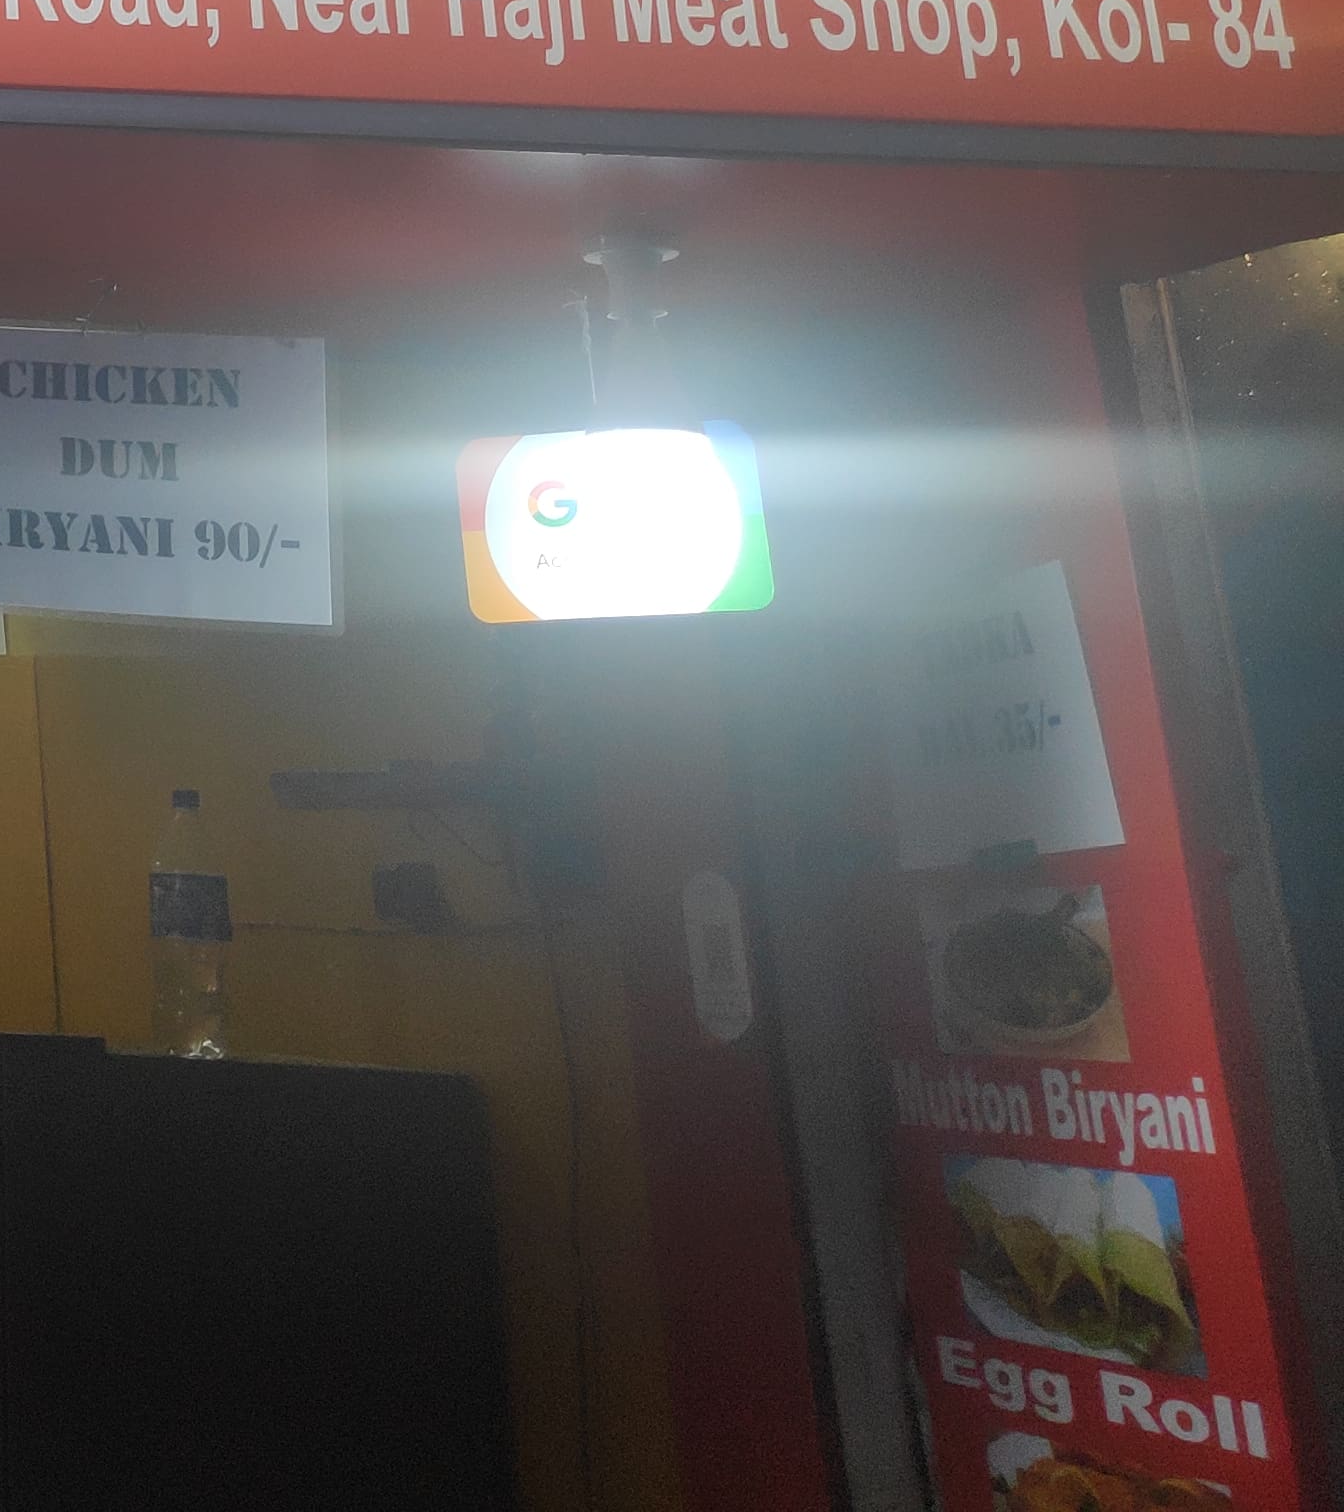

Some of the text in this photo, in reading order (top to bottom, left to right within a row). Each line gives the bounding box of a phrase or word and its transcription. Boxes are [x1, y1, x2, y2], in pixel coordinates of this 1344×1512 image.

[59, 436, 180, 482] DUM
[527, 479, 578, 528] G
[193, 518, 301, 569] 90/-
[1041, 1067, 1217, 1166] Biryani
[937, 1336, 1270, 1460] Egg Roll
